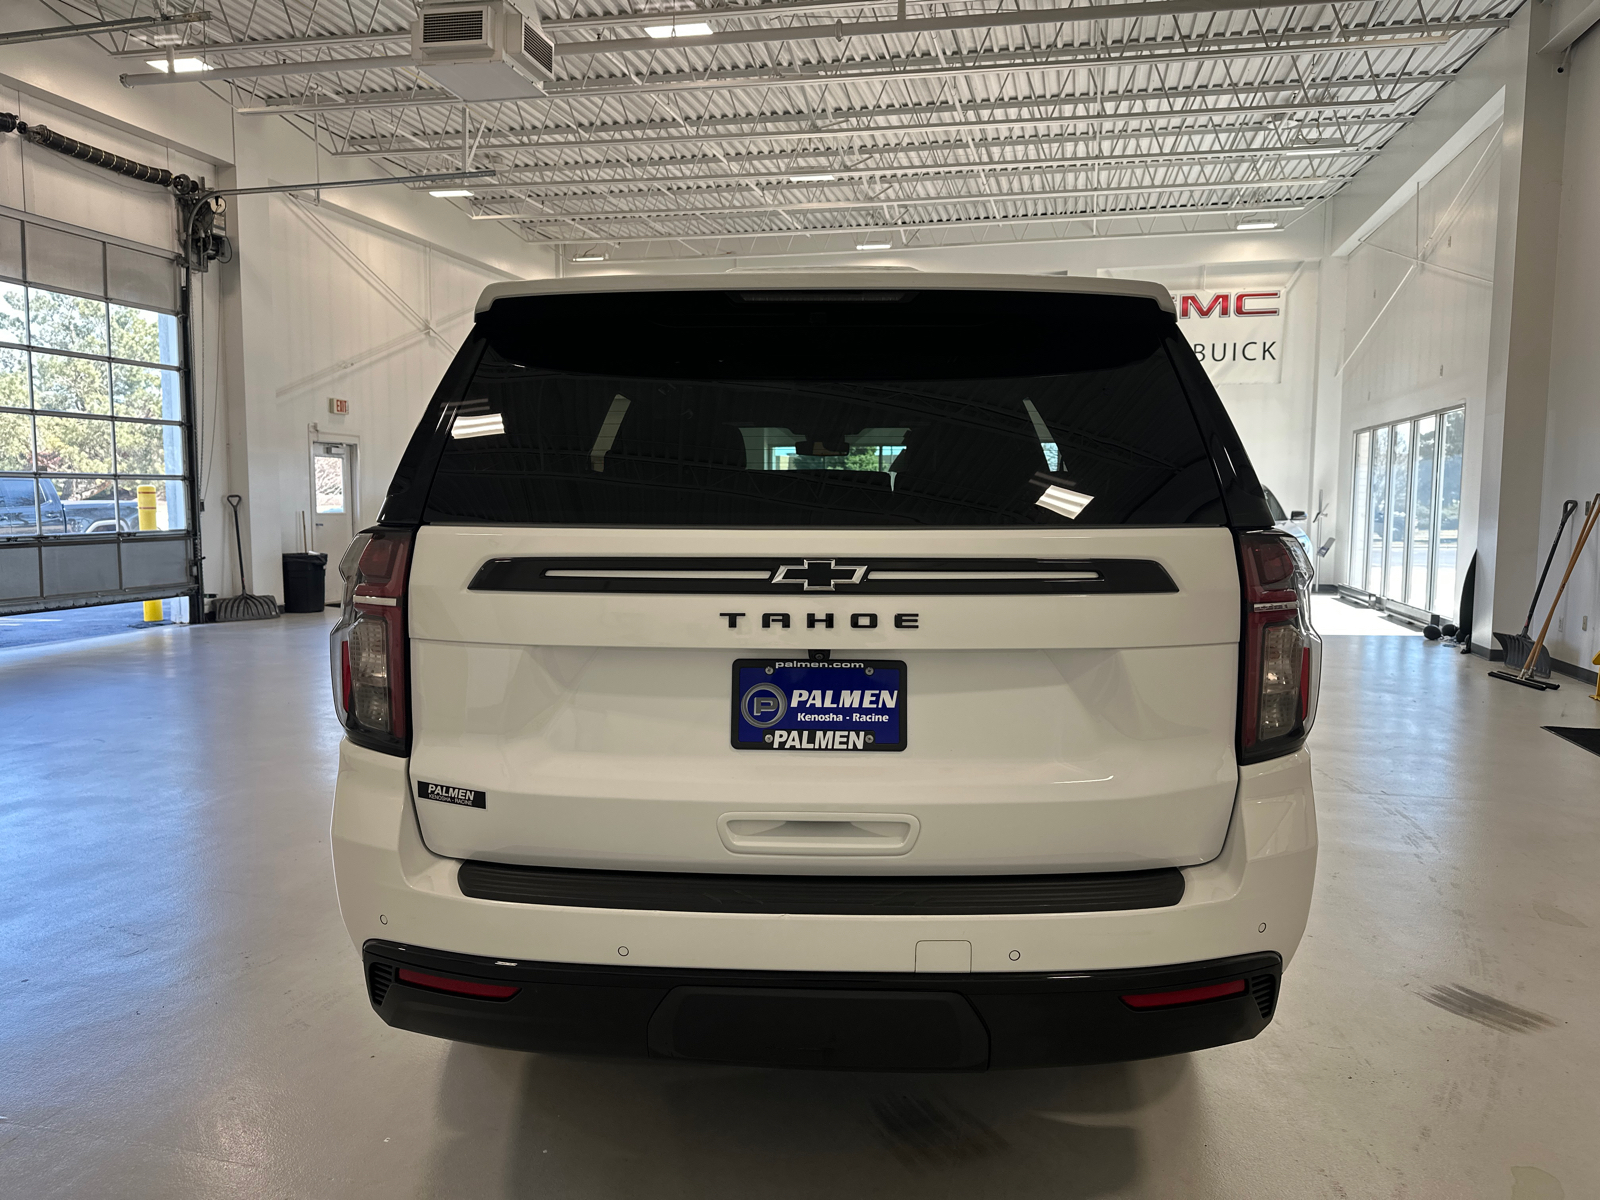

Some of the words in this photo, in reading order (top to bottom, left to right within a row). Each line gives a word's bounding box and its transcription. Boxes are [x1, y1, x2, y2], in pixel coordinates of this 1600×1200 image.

[1171, 290, 1280, 319] MC
[1193, 341, 1276, 362] BUICK
[719, 612, 919, 629] TAHOE
[775, 660, 864, 669] palmen.com
[790, 689, 898, 709] PALMEN
[797, 712, 843, 722] Kenosha
[852, 713, 889, 722] Racine
[772, 730, 865, 750] PALMEN
[428, 784, 474, 800] PALMEN
[428, 793, 451, 802] KENOSHA
